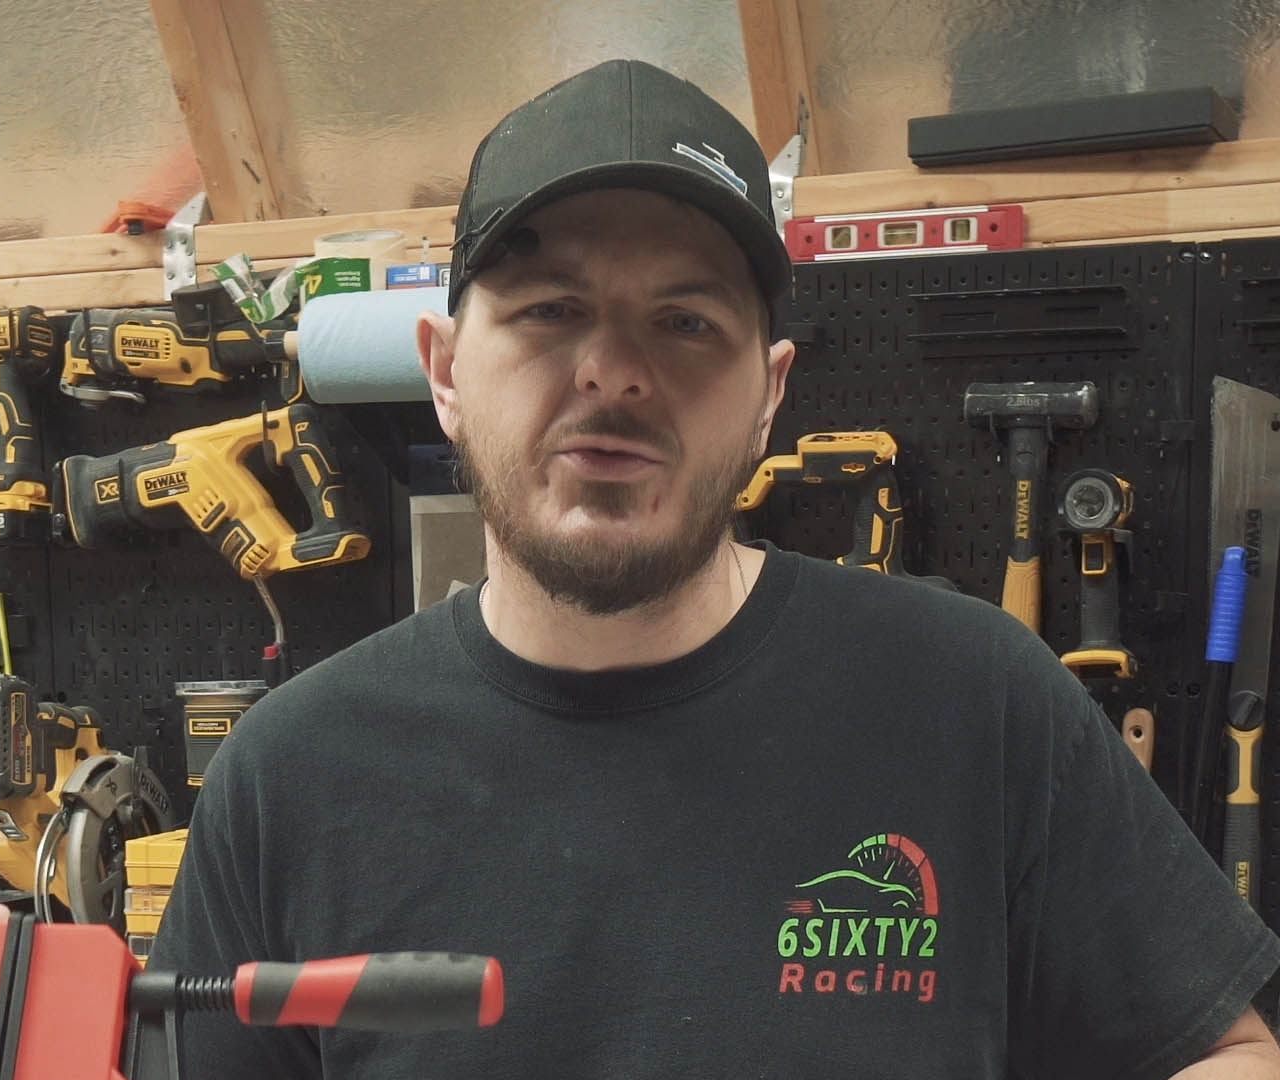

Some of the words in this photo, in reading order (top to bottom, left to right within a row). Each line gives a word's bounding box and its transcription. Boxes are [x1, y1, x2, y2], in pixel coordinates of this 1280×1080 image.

[121, 337, 160, 348] DEWALT
[100, 482, 120, 499] XR
[144, 471, 187, 491] DEWALT
[1015, 479, 1032, 541] DEWALT
[1237, 861, 1249, 900] DEWA
[777, 917, 938, 957] 6SIXTY2
[778, 962, 937, 1003] Racing
